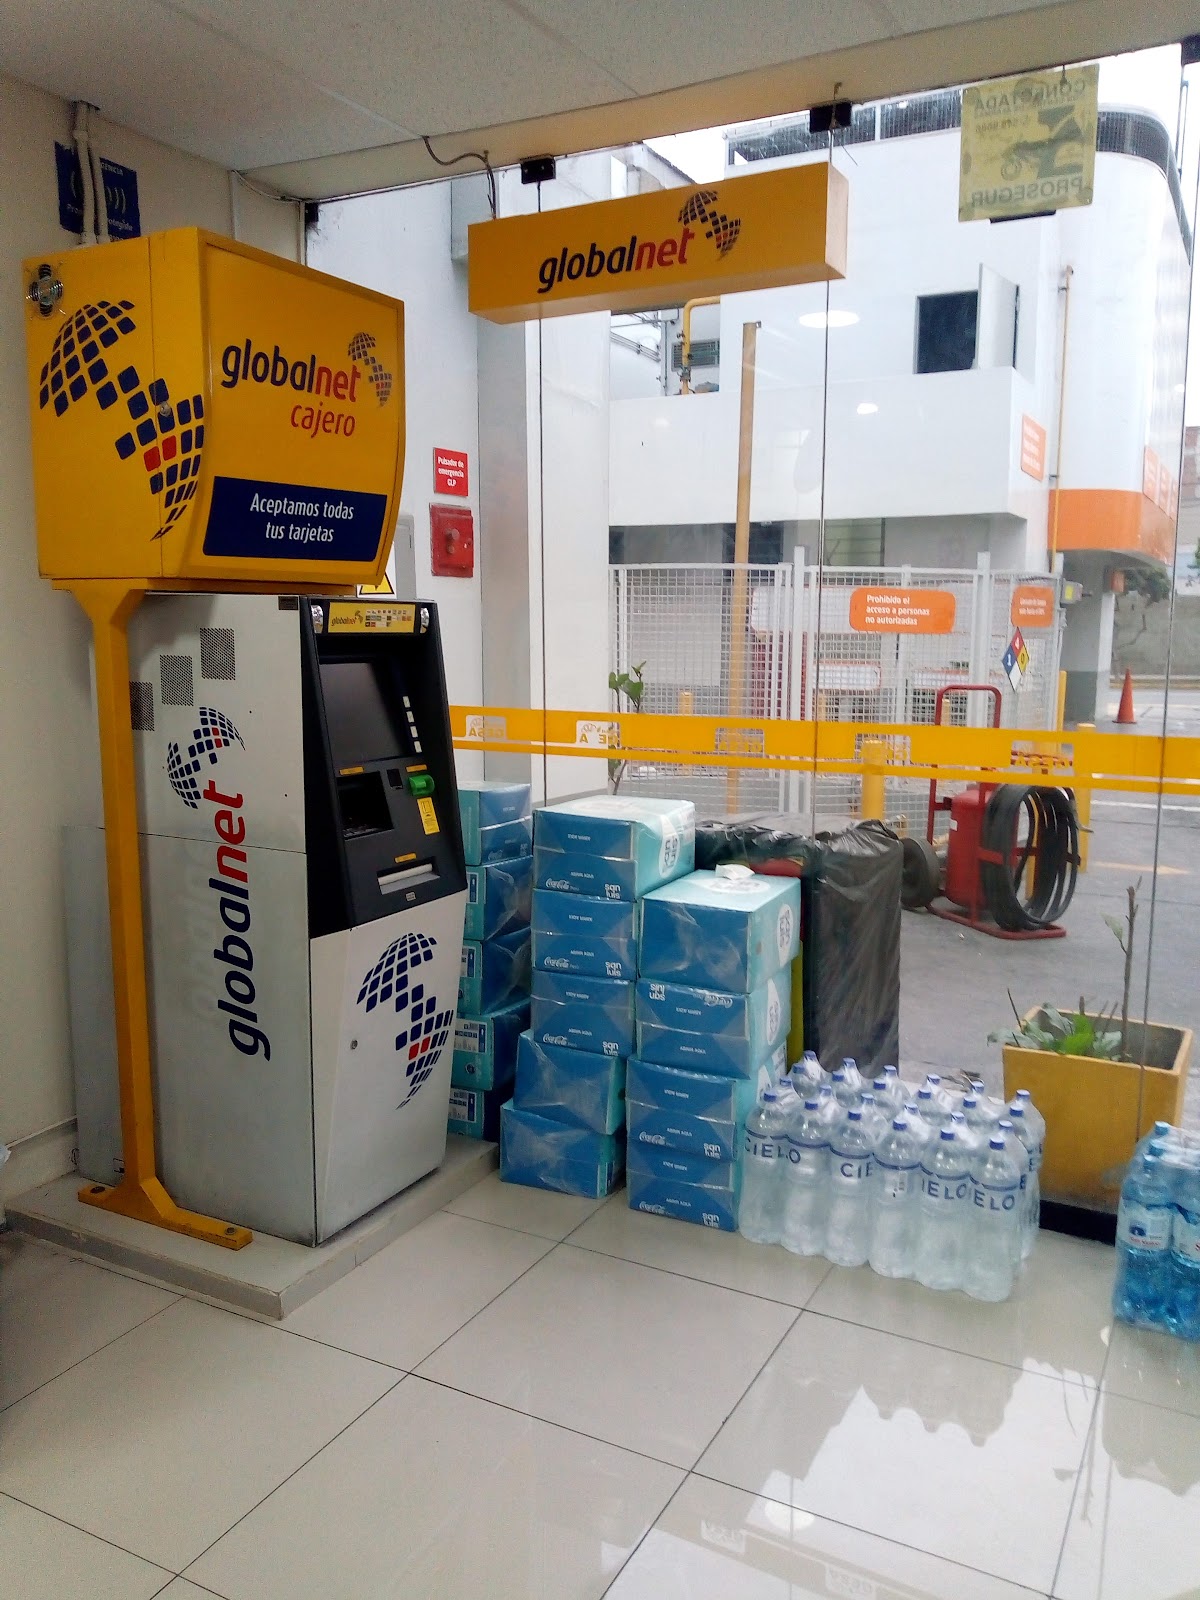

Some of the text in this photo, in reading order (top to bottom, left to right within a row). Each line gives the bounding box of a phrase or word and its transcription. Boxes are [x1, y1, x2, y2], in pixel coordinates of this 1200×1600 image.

[537, 227, 695, 294] globalnet
[221, 338, 361, 402] globalnet
[290, 401, 356, 438] cajero
[250, 493, 354, 520] Aceptamos todas
[265, 522, 334, 544] tus tarjetas
[866, 594, 910, 605] Prohibido el
[866, 606, 930, 616] acceso a personas
[865, 616, 918, 626] no autorizadas
[202, 780, 271, 1062] globalnet
